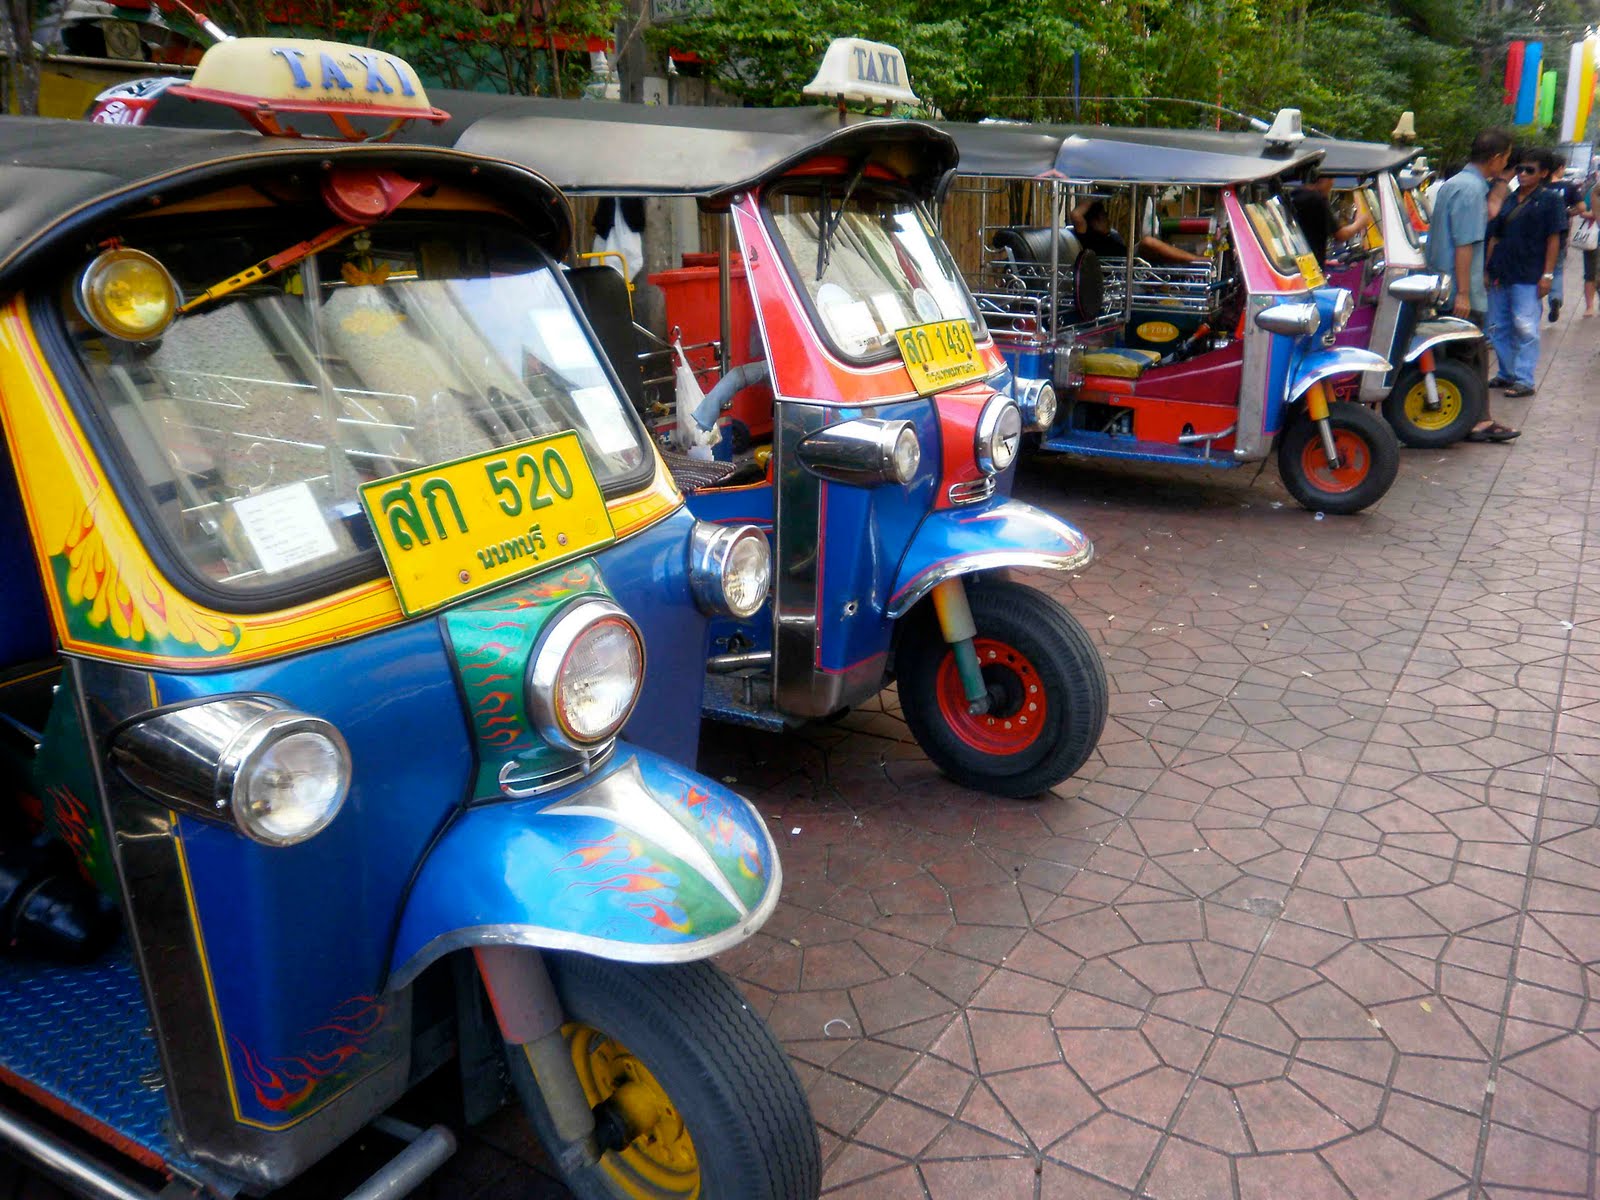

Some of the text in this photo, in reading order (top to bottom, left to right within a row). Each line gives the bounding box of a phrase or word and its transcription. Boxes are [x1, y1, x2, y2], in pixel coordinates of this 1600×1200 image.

[272, 48, 416, 97] TAXI
[853, 46, 900, 85] TAXI
[902, 323, 973, 364] สก 1431
[380, 477, 469, 550] สก
[484, 447, 573, 517] 520
[476, 524, 546, 570] นนทบุรี
